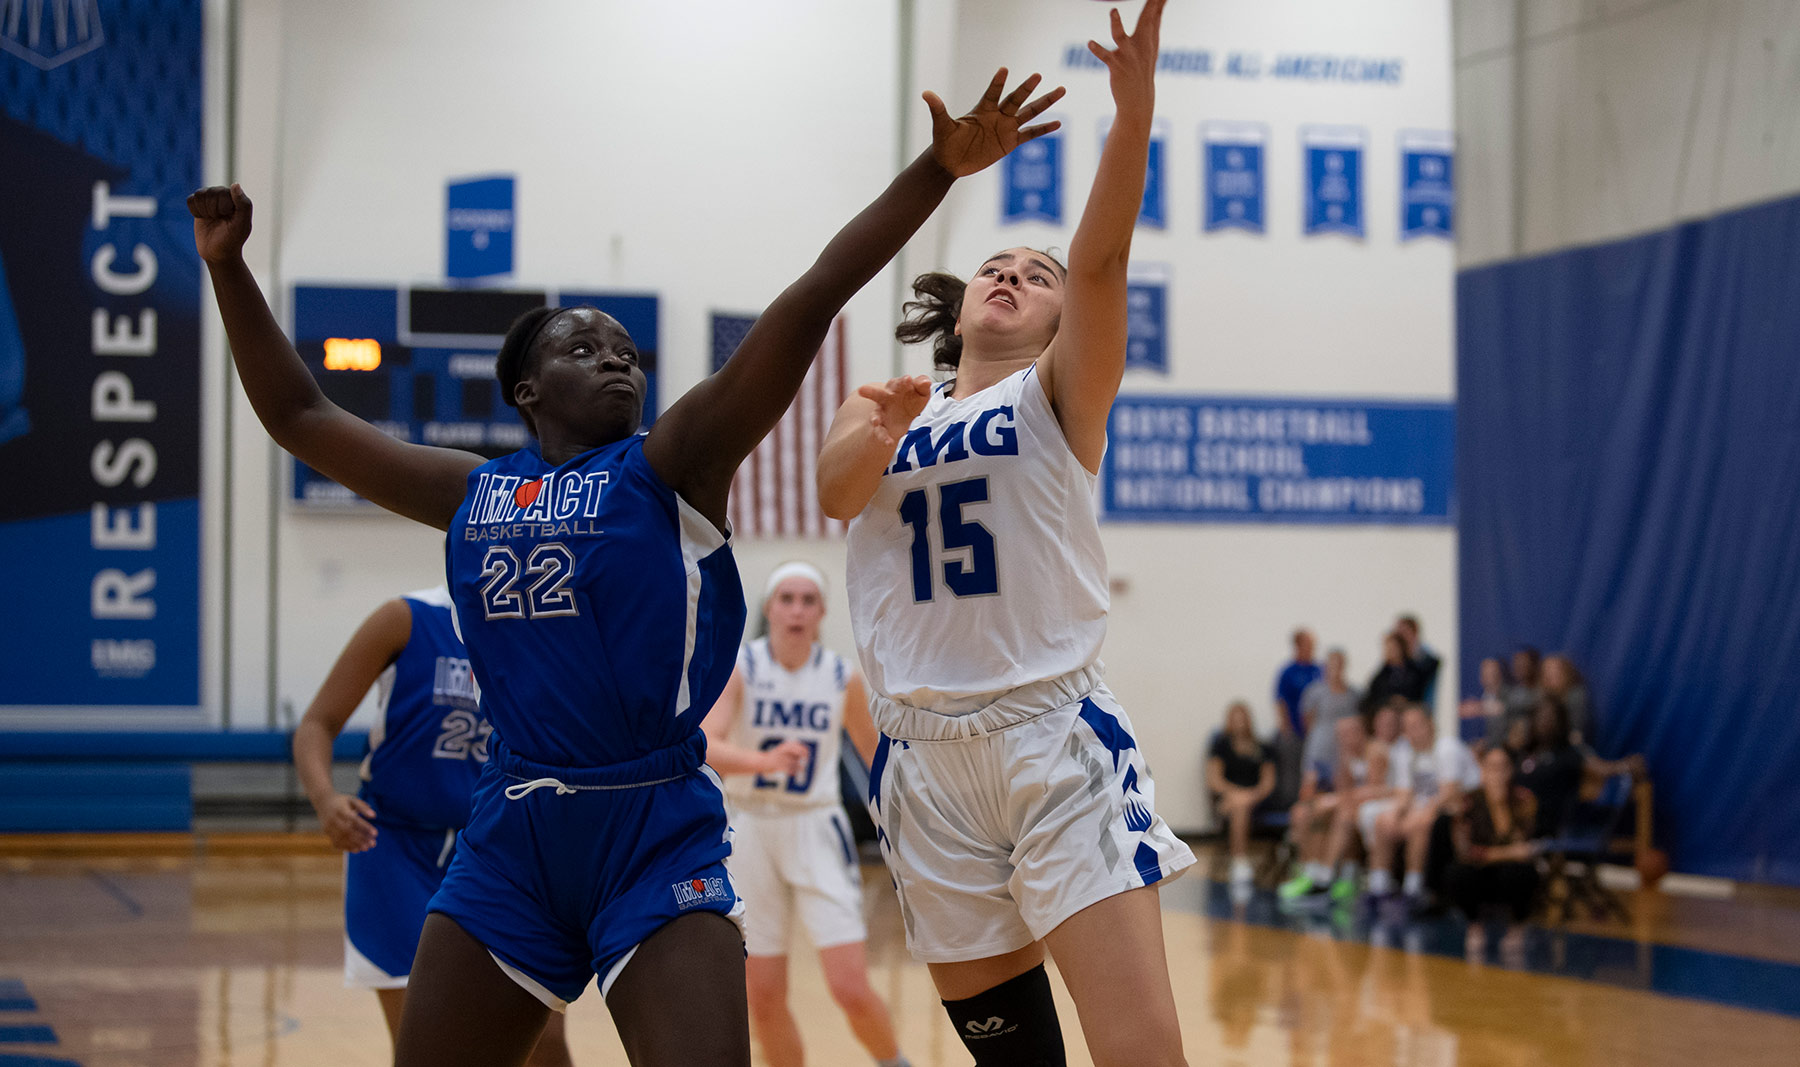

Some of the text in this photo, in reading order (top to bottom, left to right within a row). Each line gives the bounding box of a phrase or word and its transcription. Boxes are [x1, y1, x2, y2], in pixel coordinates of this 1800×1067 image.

[91, 180, 158, 620] RESPECT
[883, 404, 1019, 476] MG
[1114, 406, 1371, 445] BOYS BASKETBALL
[1114, 441, 1307, 477] HIGH SCHOOL
[467, 471, 609, 525] IMPACT
[1114, 475, 1423, 513] NATIONAL CHAMPIONS
[464, 520, 604, 542] BASKETBALL
[896, 474, 1001, 605] 15
[480, 542, 580, 622] 22
[752, 700, 831, 732] IMG
[672, 877, 727, 904] IMPACT
[679, 896, 732, 910] BASKETBALL
